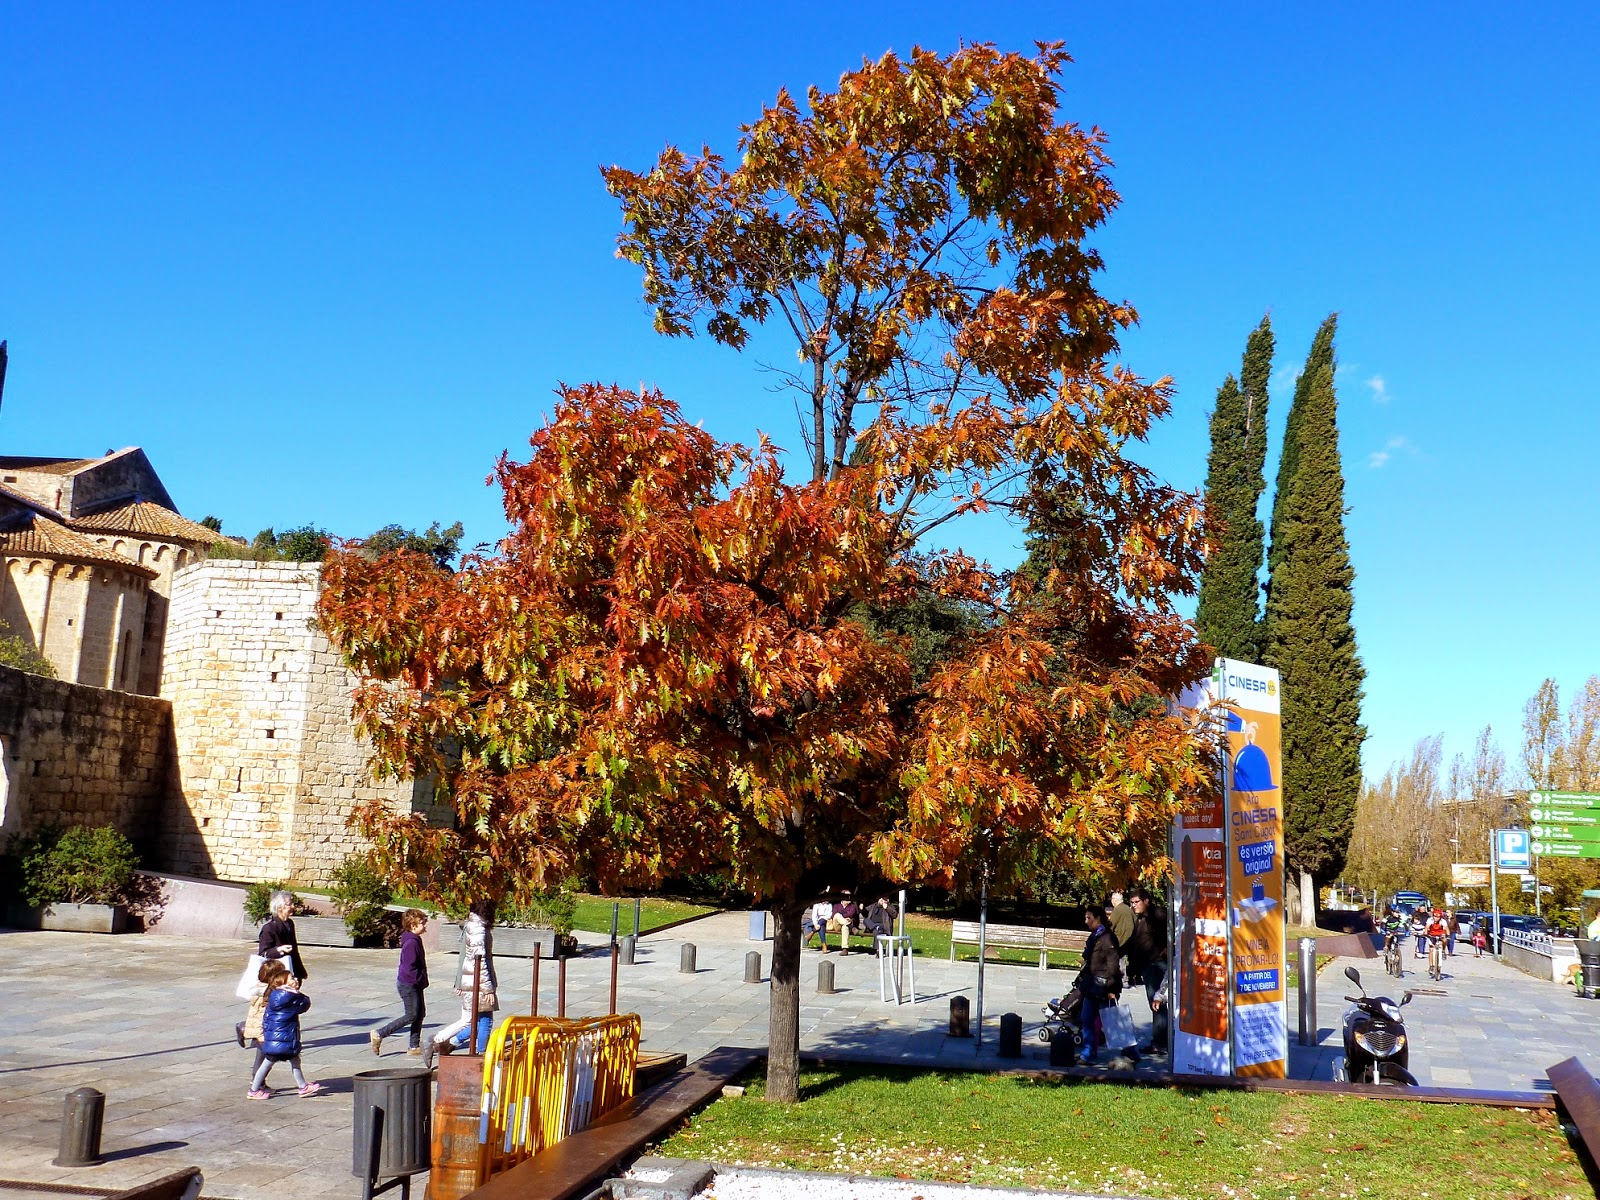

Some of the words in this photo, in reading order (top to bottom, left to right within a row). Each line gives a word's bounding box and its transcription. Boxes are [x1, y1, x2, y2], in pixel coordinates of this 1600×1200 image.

[1228, 675, 1267, 693] CINESA
[1232, 807, 1277, 826] CINESA
[1234, 828, 1252, 842] Sant
[1254, 825, 1276, 839] Cugat
[1240, 846, 1250, 859] és
[1251, 842, 1274, 857] versió
[1504, 834, 1523, 852] P
[1245, 856, 1271, 875] original
[1243, 973, 1248, 981] A
[1244, 984, 1252, 992] DE
